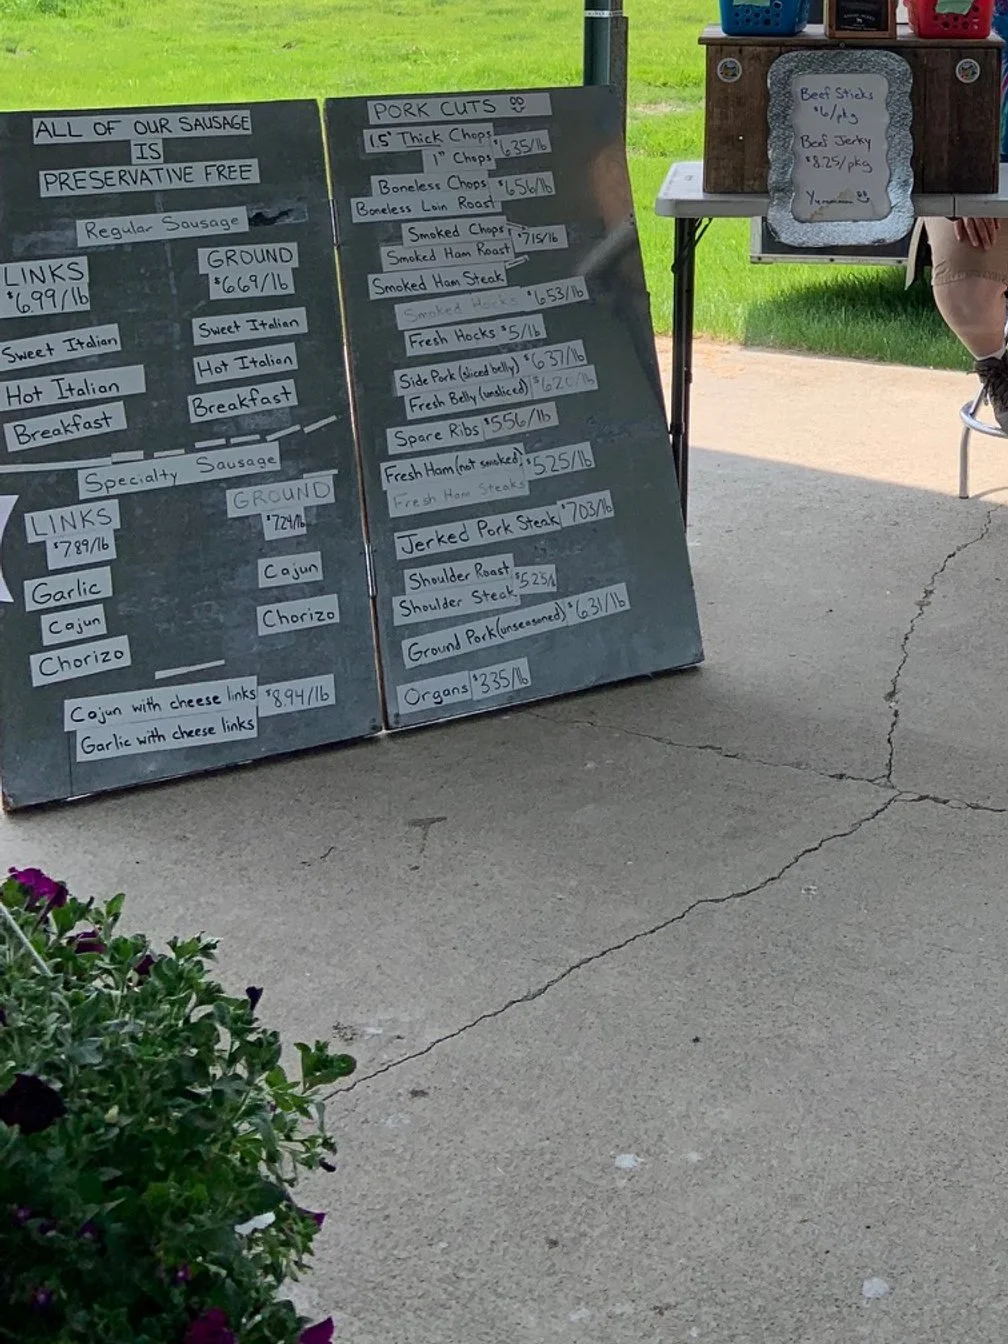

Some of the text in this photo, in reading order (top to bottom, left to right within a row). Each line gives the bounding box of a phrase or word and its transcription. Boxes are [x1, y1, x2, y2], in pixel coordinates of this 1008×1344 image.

[801, 86, 873, 101] Beef Sticks
[373, 99, 497, 120] PORK CUTS
[35, 114, 250, 139] ALL OF OUR SAUSAGE
[450, 128, 492, 144] Chops
[134, 142, 161, 160] IS
[800, 134, 871, 152] Beef Jerky
[454, 151, 493, 166] Chops
[44, 163, 252, 192] PRESERVATIVE FREE
[379, 175, 487, 194] Boneless Chops
[356, 195, 496, 216] Boneless Roast
[85, 215, 239, 241] Regular Sausage
[408, 223, 460, 242] Smoked
[207, 247, 294, 268] GROUND
[387, 240, 511, 265] Smoked Ham Roast
[3, 262, 84, 287] LINKS
[371, 270, 505, 296] Smoked Ham Steak
[199, 317, 300, 338] Sweet Italian
[408, 327, 496, 351] Fresh Hocks
[1, 335, 118, 363] Sweet Italian
[197, 354, 293, 378] Hot Italian
[6, 377, 120, 406] Hot Italian
[399, 372, 429, 391] Side
[192, 385, 292, 417] Breakfast
[409, 394, 445, 413] Fresh
[13, 412, 113, 446] Breakfast
[394, 418, 480, 447] Spare Ribs
[84, 454, 277, 494] Specialty Sausage
[385, 459, 454, 483] Fresh Ham
[233, 482, 331, 510] GROUND
[30, 508, 113, 538] LINKS
[396, 512, 560, 556] Jerked Pork Steak
[263, 562, 318, 582] Cajun
[408, 558, 511, 592] Shoulder Roast
[31, 580, 102, 606] Garlic
[400, 586, 519, 618] Shoulder Steak
[48, 616, 101, 635] Cajun
[262, 607, 335, 627] Chorizo
[407, 634, 462, 663] Ground
[38, 648, 125, 677] Chorizo
[404, 683, 469, 706] Organs
[70, 691, 222, 725] Cajun with cheese
[80, 716, 255, 754] Garlic with cheese links
